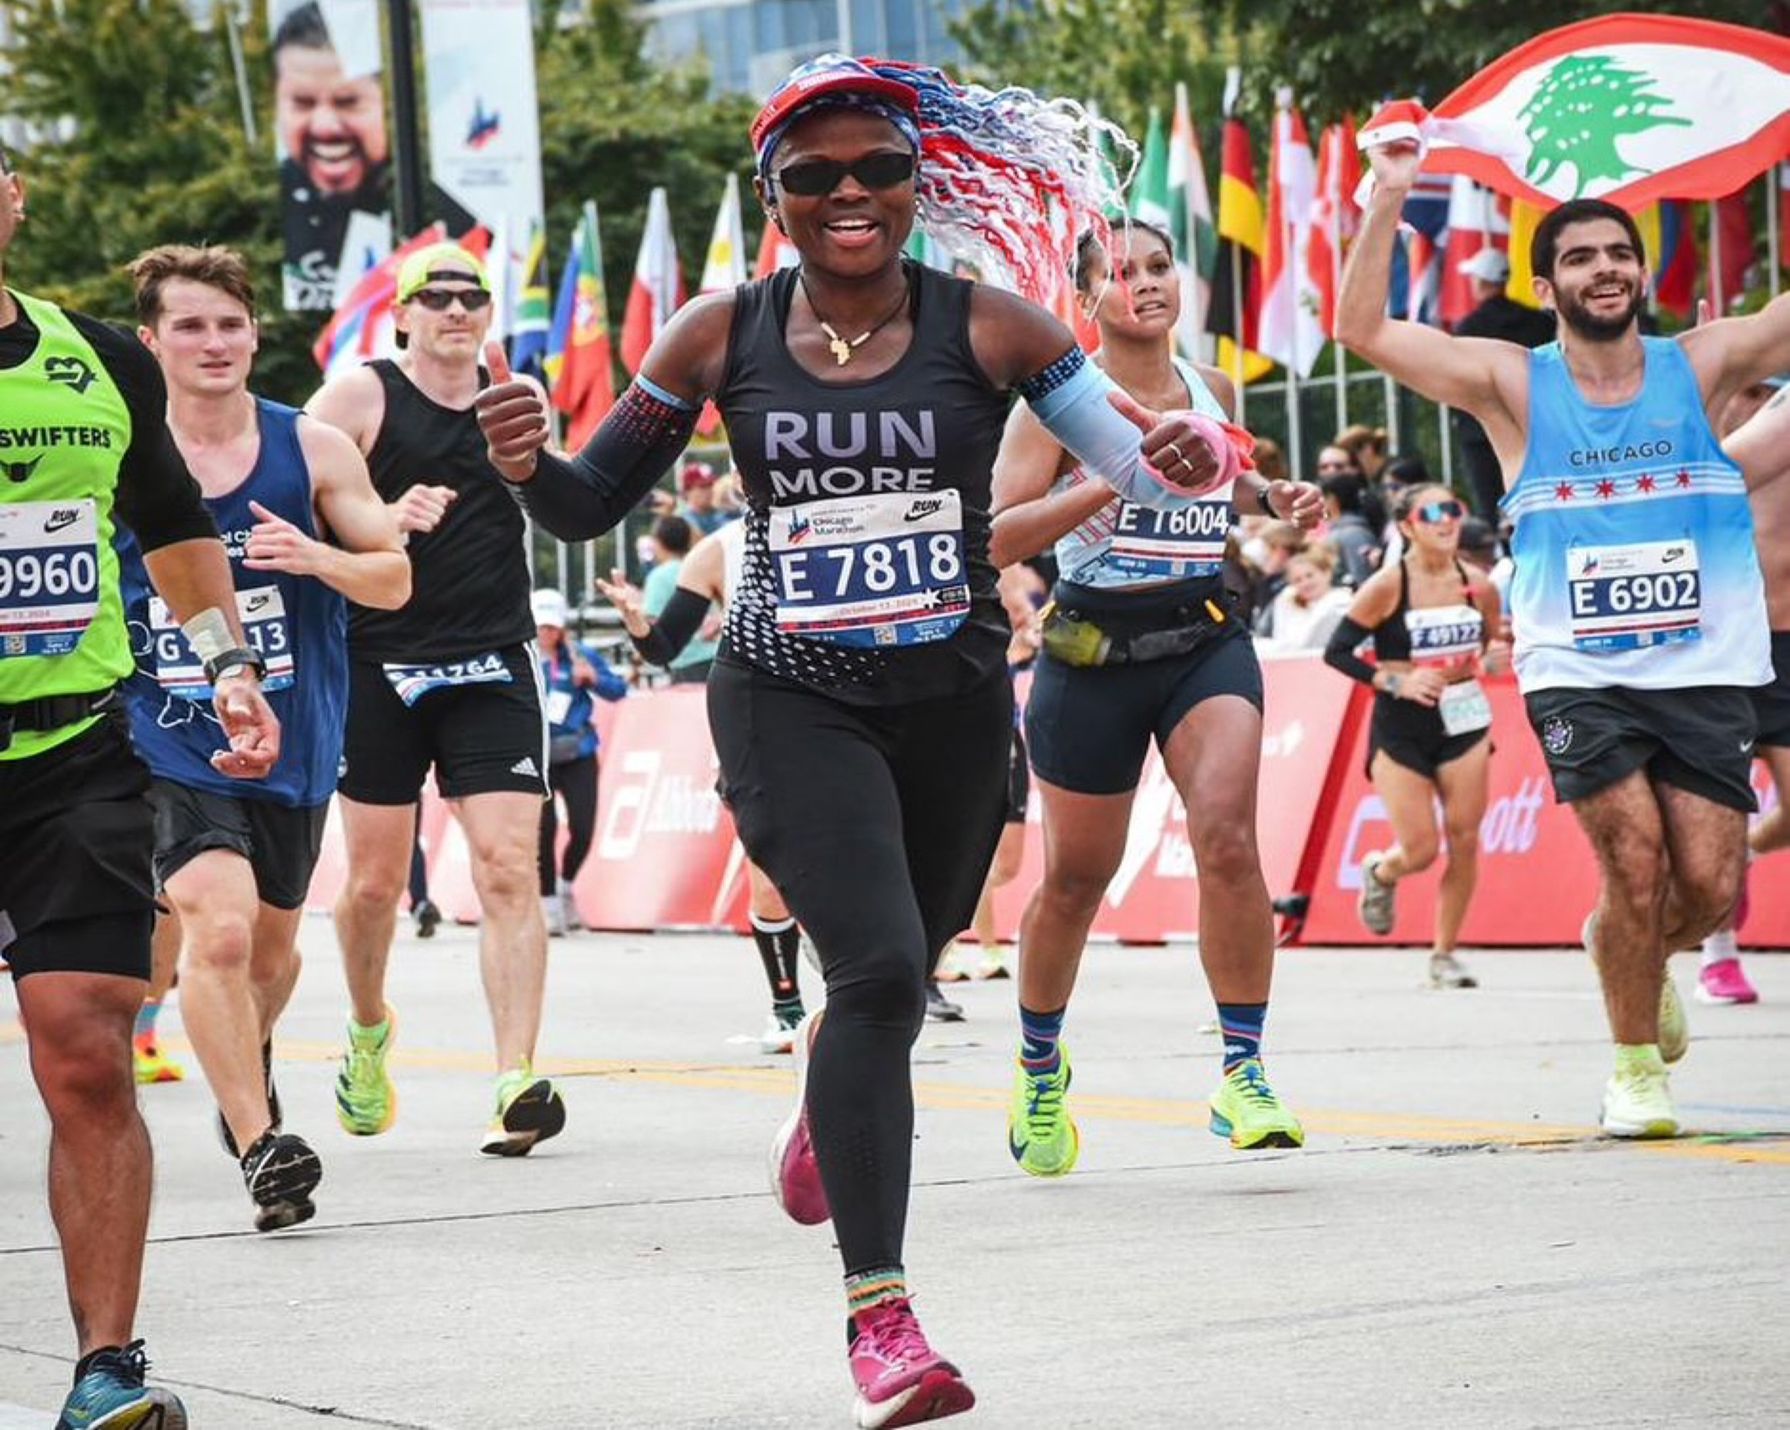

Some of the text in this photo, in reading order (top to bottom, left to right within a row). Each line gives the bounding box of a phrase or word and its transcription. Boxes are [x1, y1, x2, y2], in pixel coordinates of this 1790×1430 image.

[0, 426, 111, 449] SWIFTERS
[765, 409, 936, 461] RUN
[1570, 440, 1673, 466] CHICAGO
[769, 466, 935, 498] MORE
[50, 508, 79, 523] RUN
[911, 499, 942, 513] RUN
[1119, 503, 1140, 531] E
[779, 534, 961, 601] E 7818
[1573, 571, 1698, 615] E 6902
[157, 632, 181, 662] G
